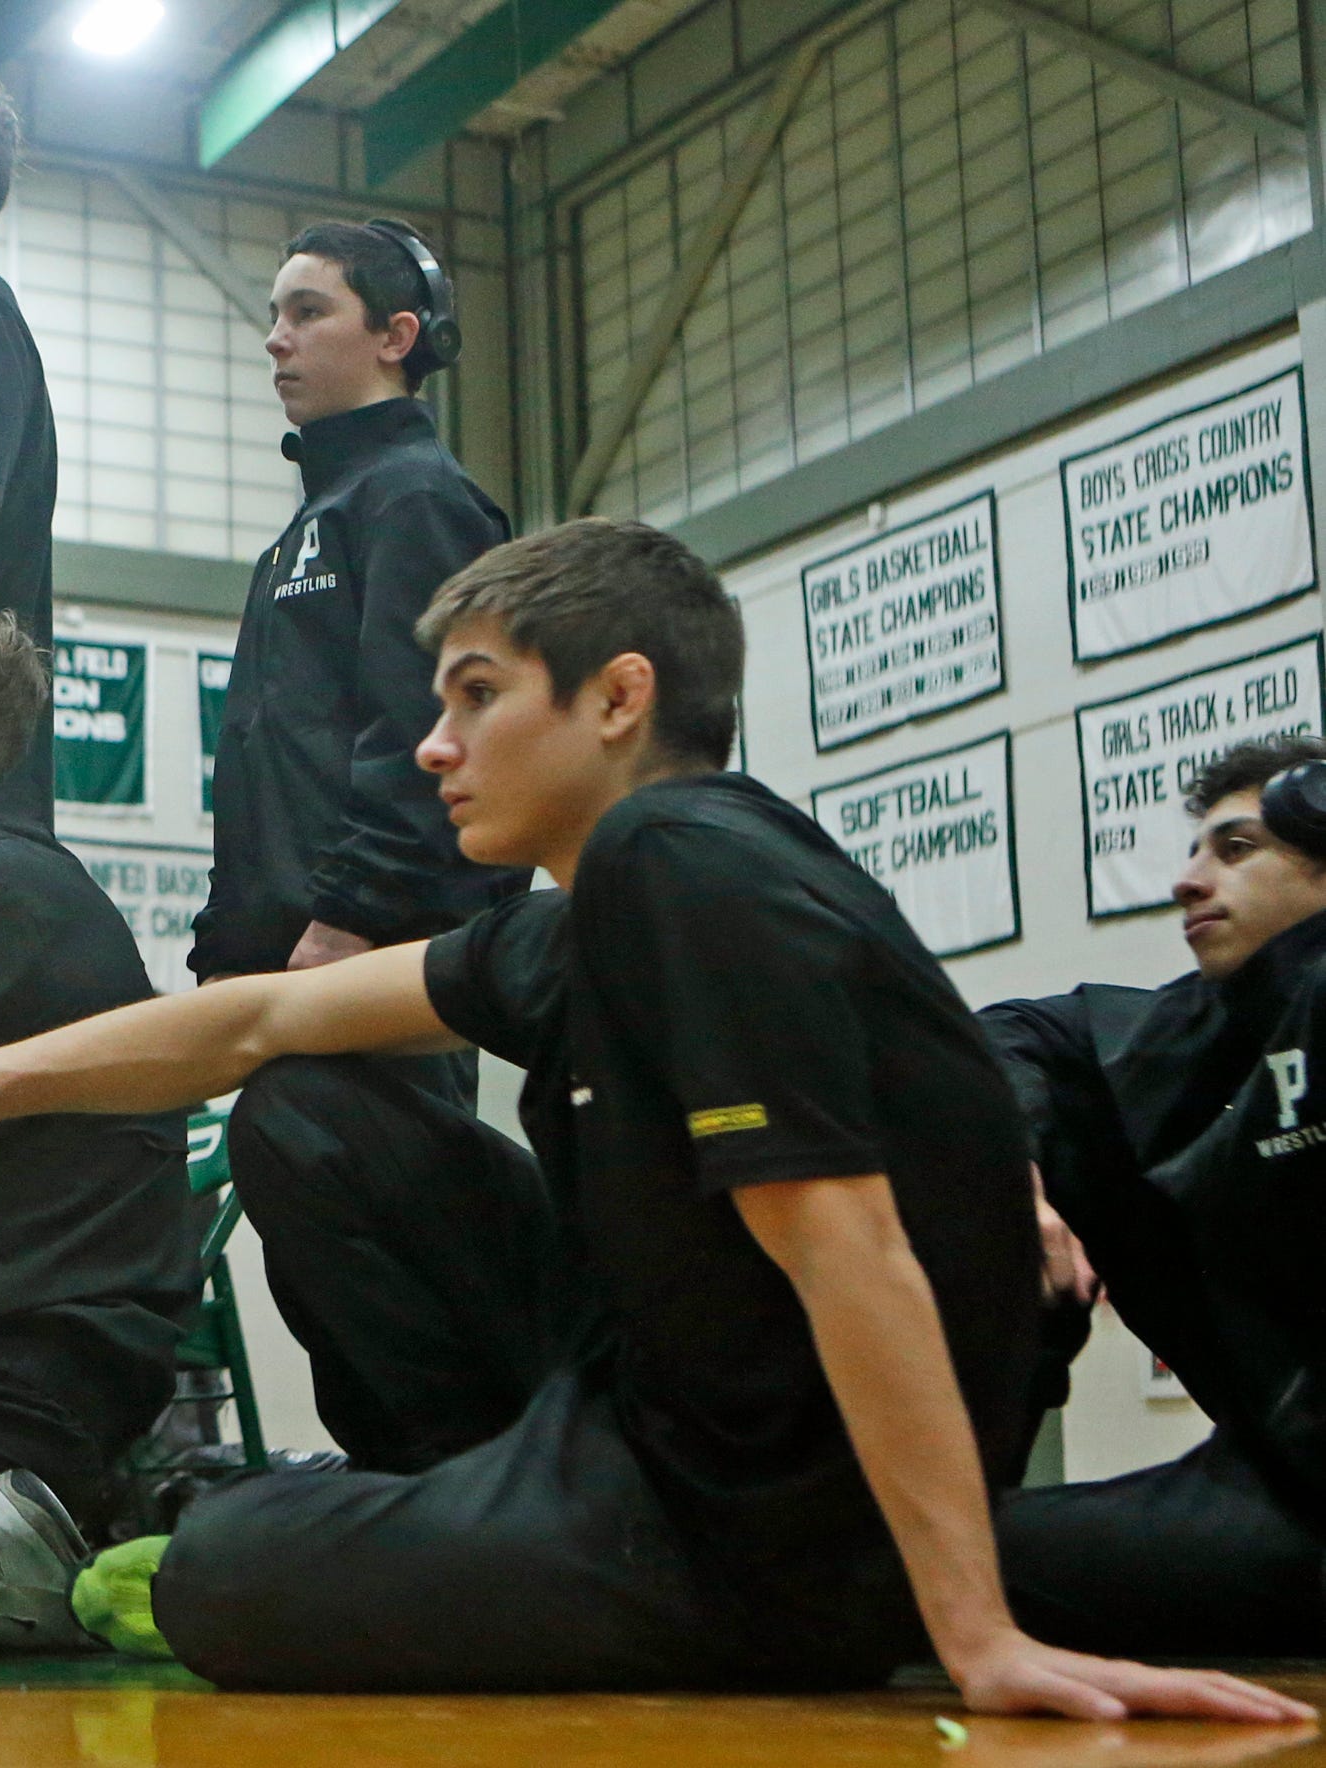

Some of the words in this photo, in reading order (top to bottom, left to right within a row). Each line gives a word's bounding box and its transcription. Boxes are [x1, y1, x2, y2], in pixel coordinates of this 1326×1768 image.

[1079, 461, 1126, 511] BOYS
[1133, 434, 1190, 490] CROSS
[1198, 396, 1283, 466] COUNTRY
[1079, 505, 1152, 560] STATE
[1159, 451, 1294, 534] CHAMPIONS
[274, 573, 337, 600] WRESTLING
[290, 517, 321, 580] P
[810, 565, 860, 615] GIRLS
[866, 517, 988, 593] BASKETBALL
[815, 608, 874, 659] STATE
[880, 566, 986, 635] CHAMPIONS
[1101, 711, 1150, 761] GIRLS
[1158, 690, 1217, 747] TRACK
[1243, 665, 1298, 720] FIELD
[840, 763, 983, 837] SOFTBALL
[1093, 763, 1168, 815] STATE
[891, 809, 998, 872] CHAMPIONS
[1265, 1048, 1307, 1130] P
